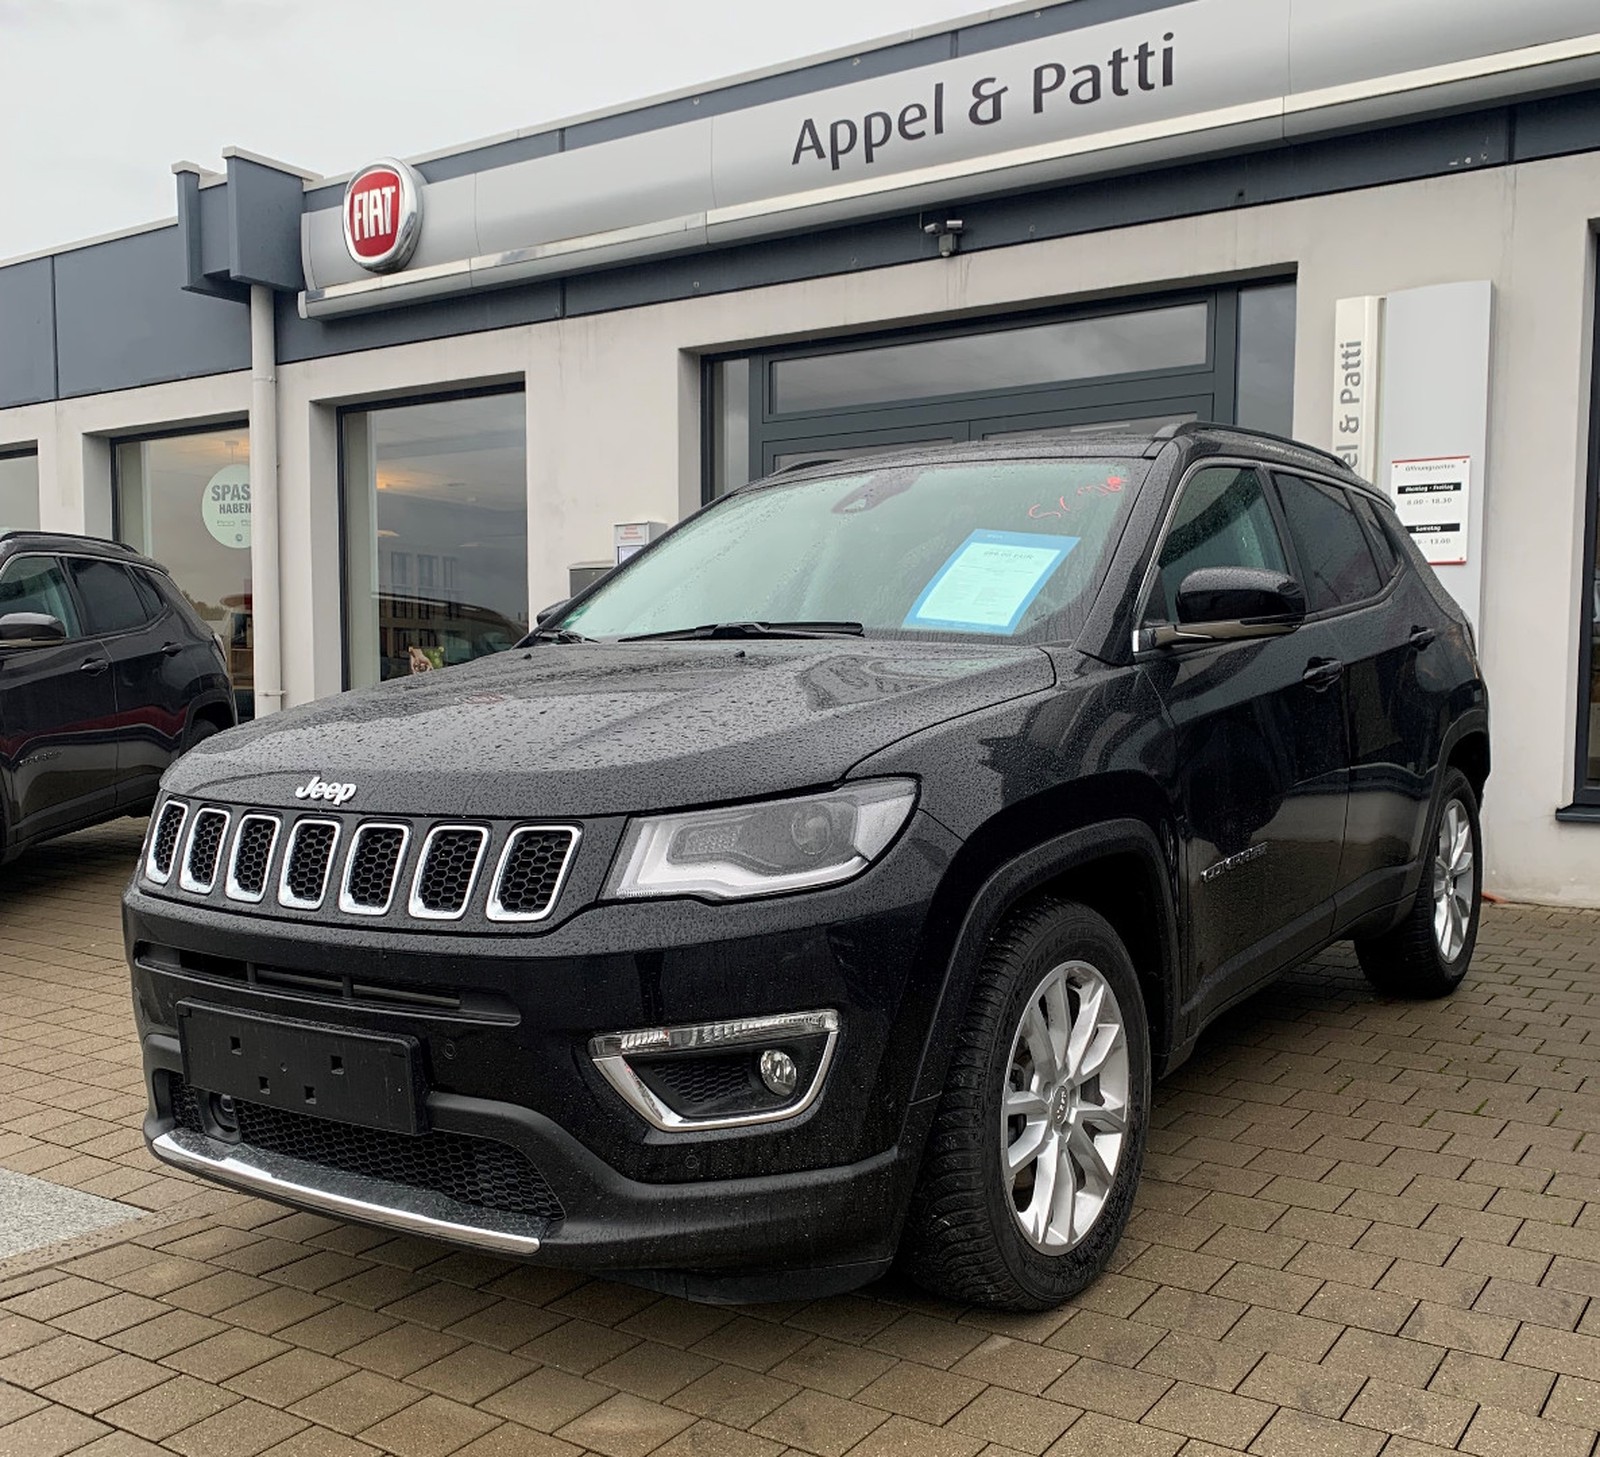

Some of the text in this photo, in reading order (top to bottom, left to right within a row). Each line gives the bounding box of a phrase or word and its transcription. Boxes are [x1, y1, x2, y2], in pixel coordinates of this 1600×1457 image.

[791, 31, 1175, 171] Appel & Patti
[353, 185, 396, 242] FIAT
[1339, 340, 1362, 405] Patti
[1339, 414, 1360, 434] &
[219, 502, 252, 515] HABEN
[294, 776, 357, 806] Jeep
